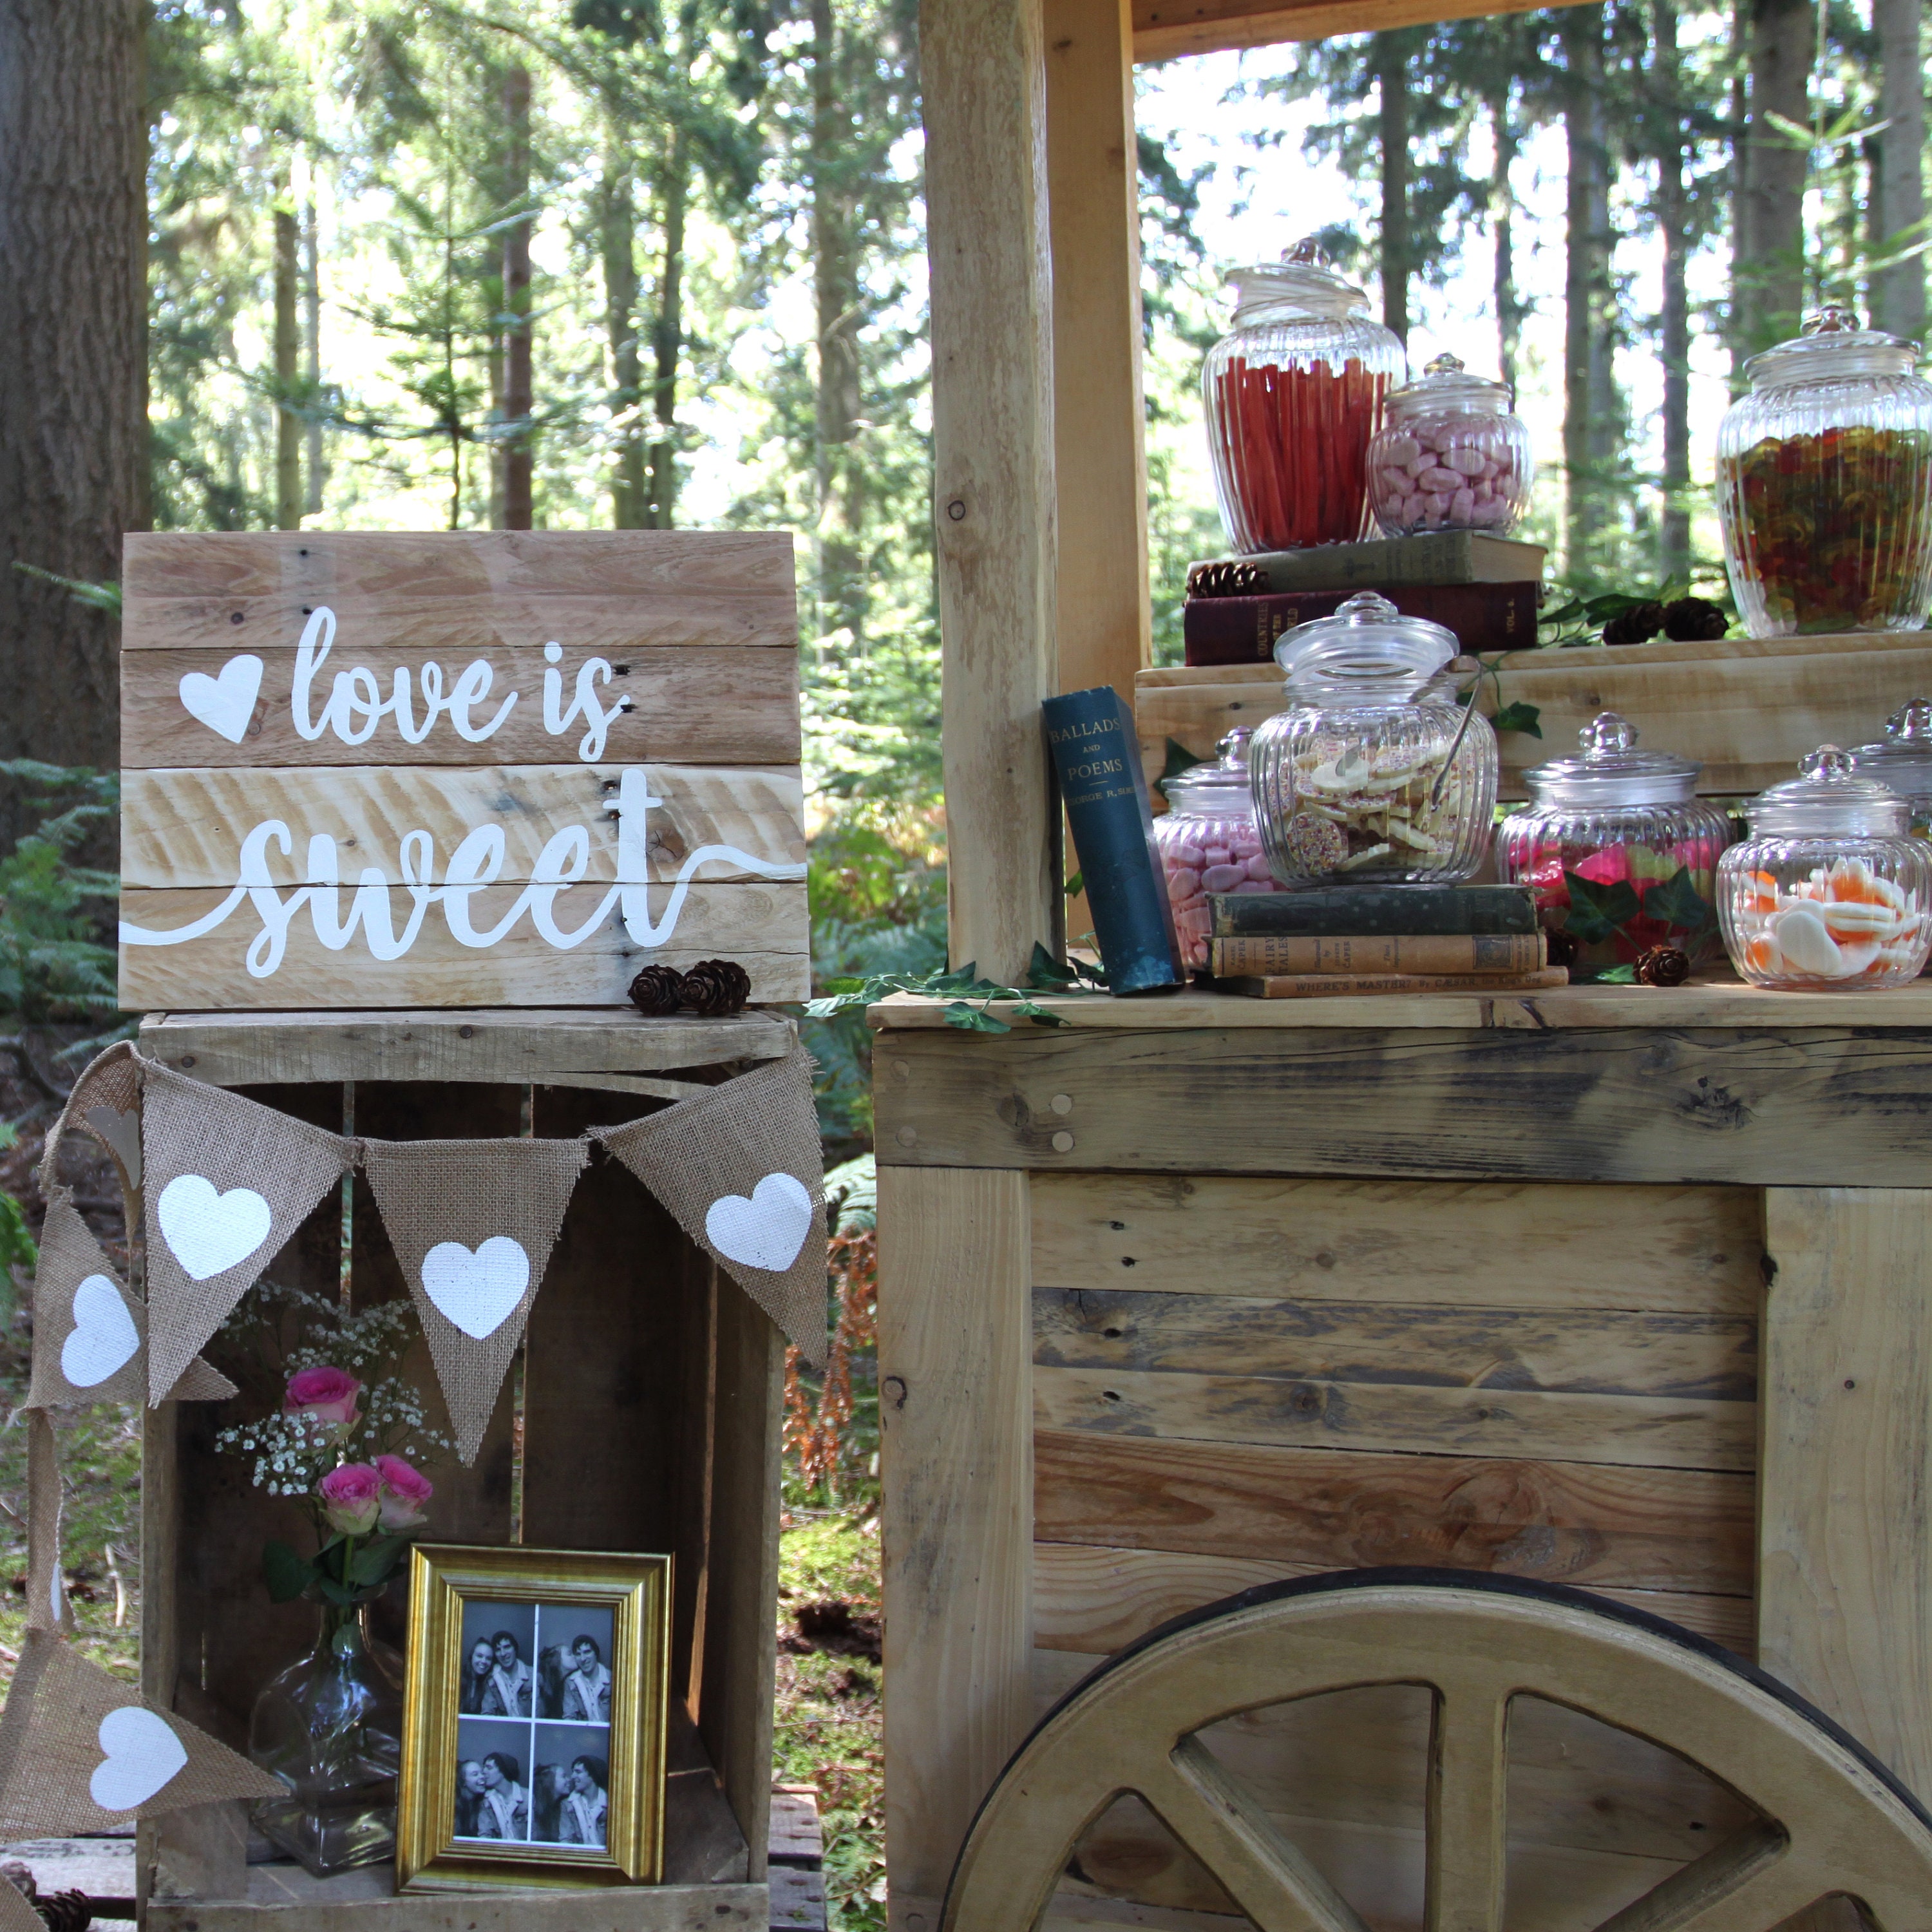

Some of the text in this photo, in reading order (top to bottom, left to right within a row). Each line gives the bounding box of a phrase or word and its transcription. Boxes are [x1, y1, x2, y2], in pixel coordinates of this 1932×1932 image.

[1256, 601, 1269, 657] COUNTRIES
[1287, 607, 1298, 629] RLD
[290, 606, 630, 762] love is
[1050, 717, 1121, 744] BALLADS
[1083, 744, 1101, 753] AND
[1066, 759, 1123, 781] POEMS
[1106, 789, 1117, 799] R.
[118, 768, 808, 978] sweet
[1265, 937, 1275, 975] FAIRY
[1278, 936, 1289, 974] TALES
[1296, 981, 1350, 992] WHERE'S
[1356, 980, 1412, 990] MASTER?
